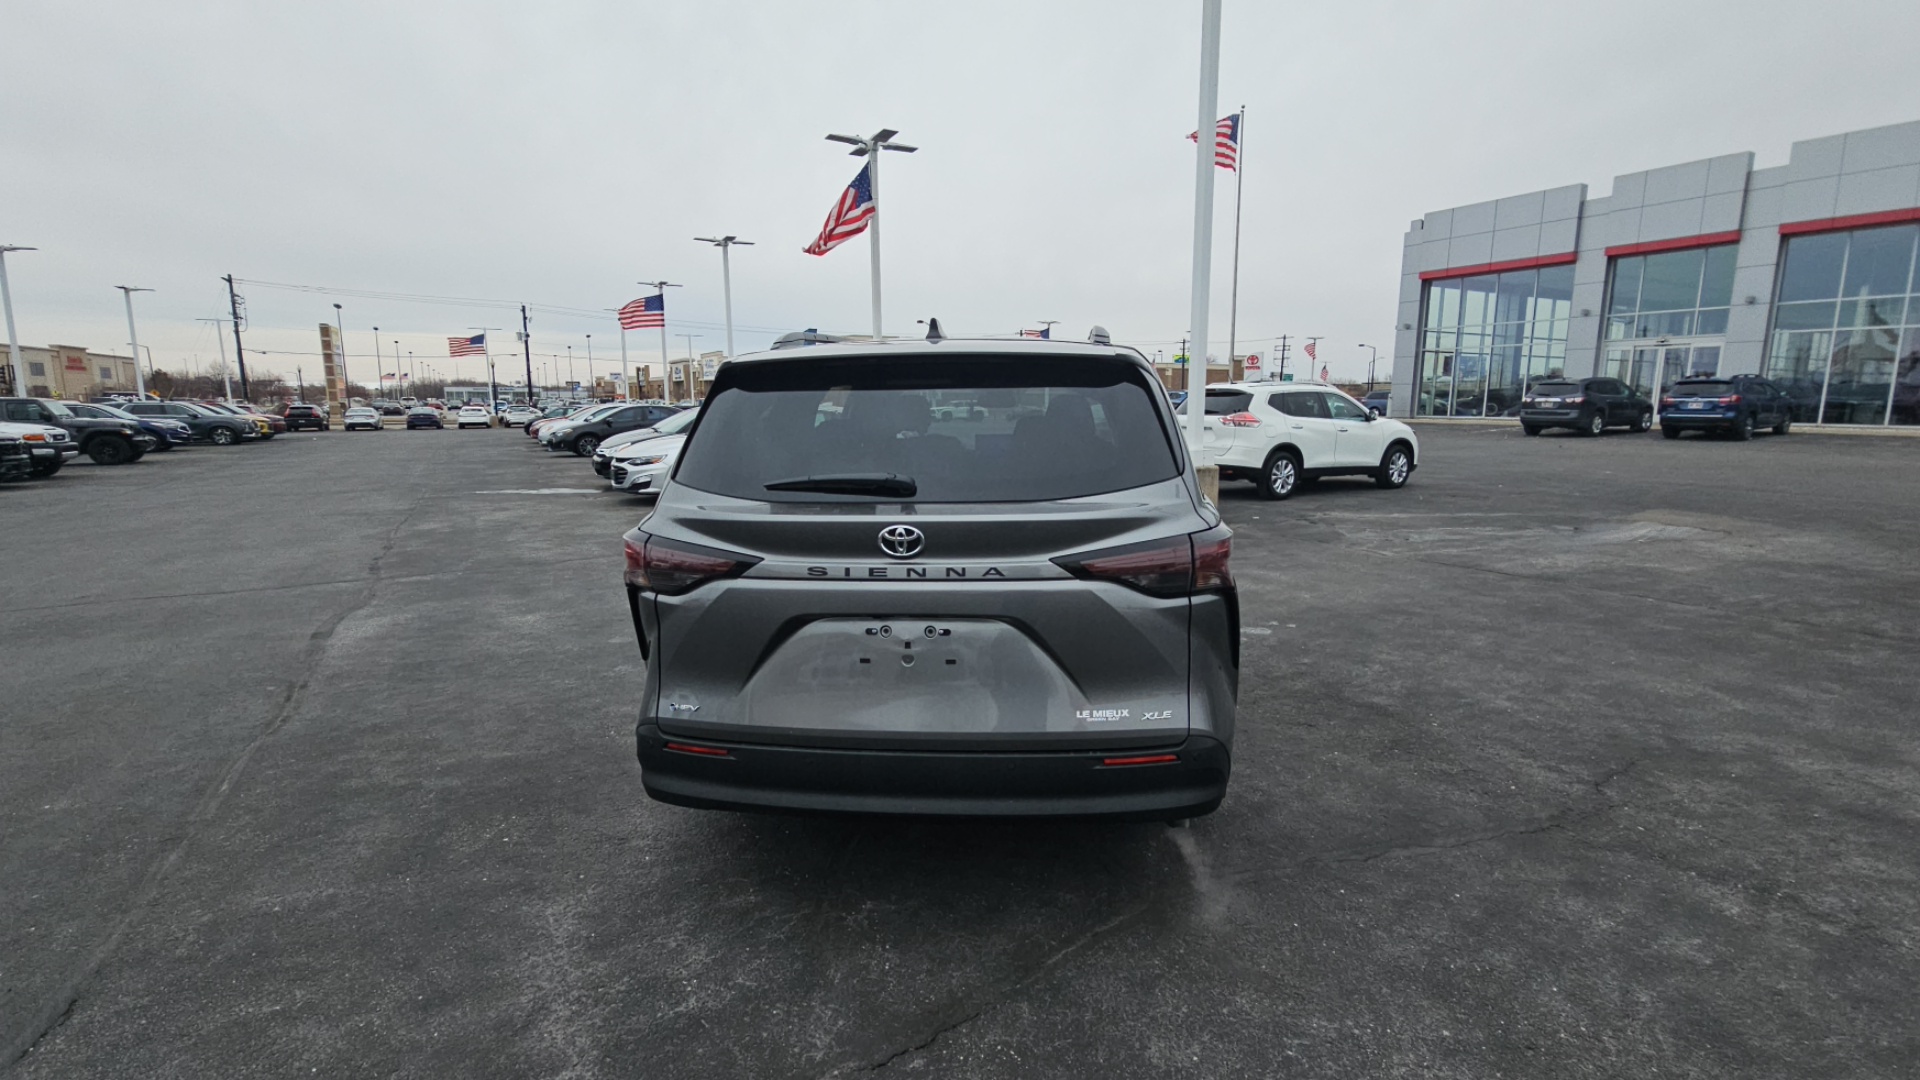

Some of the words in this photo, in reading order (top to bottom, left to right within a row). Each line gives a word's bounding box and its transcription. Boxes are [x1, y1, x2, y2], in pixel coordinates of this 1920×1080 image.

[807, 566, 1006, 577] SIENNA
[1076, 710, 1090, 718] LE
[1092, 709, 1130, 717] MIEUX
[1141, 710, 1172, 720] XLE
